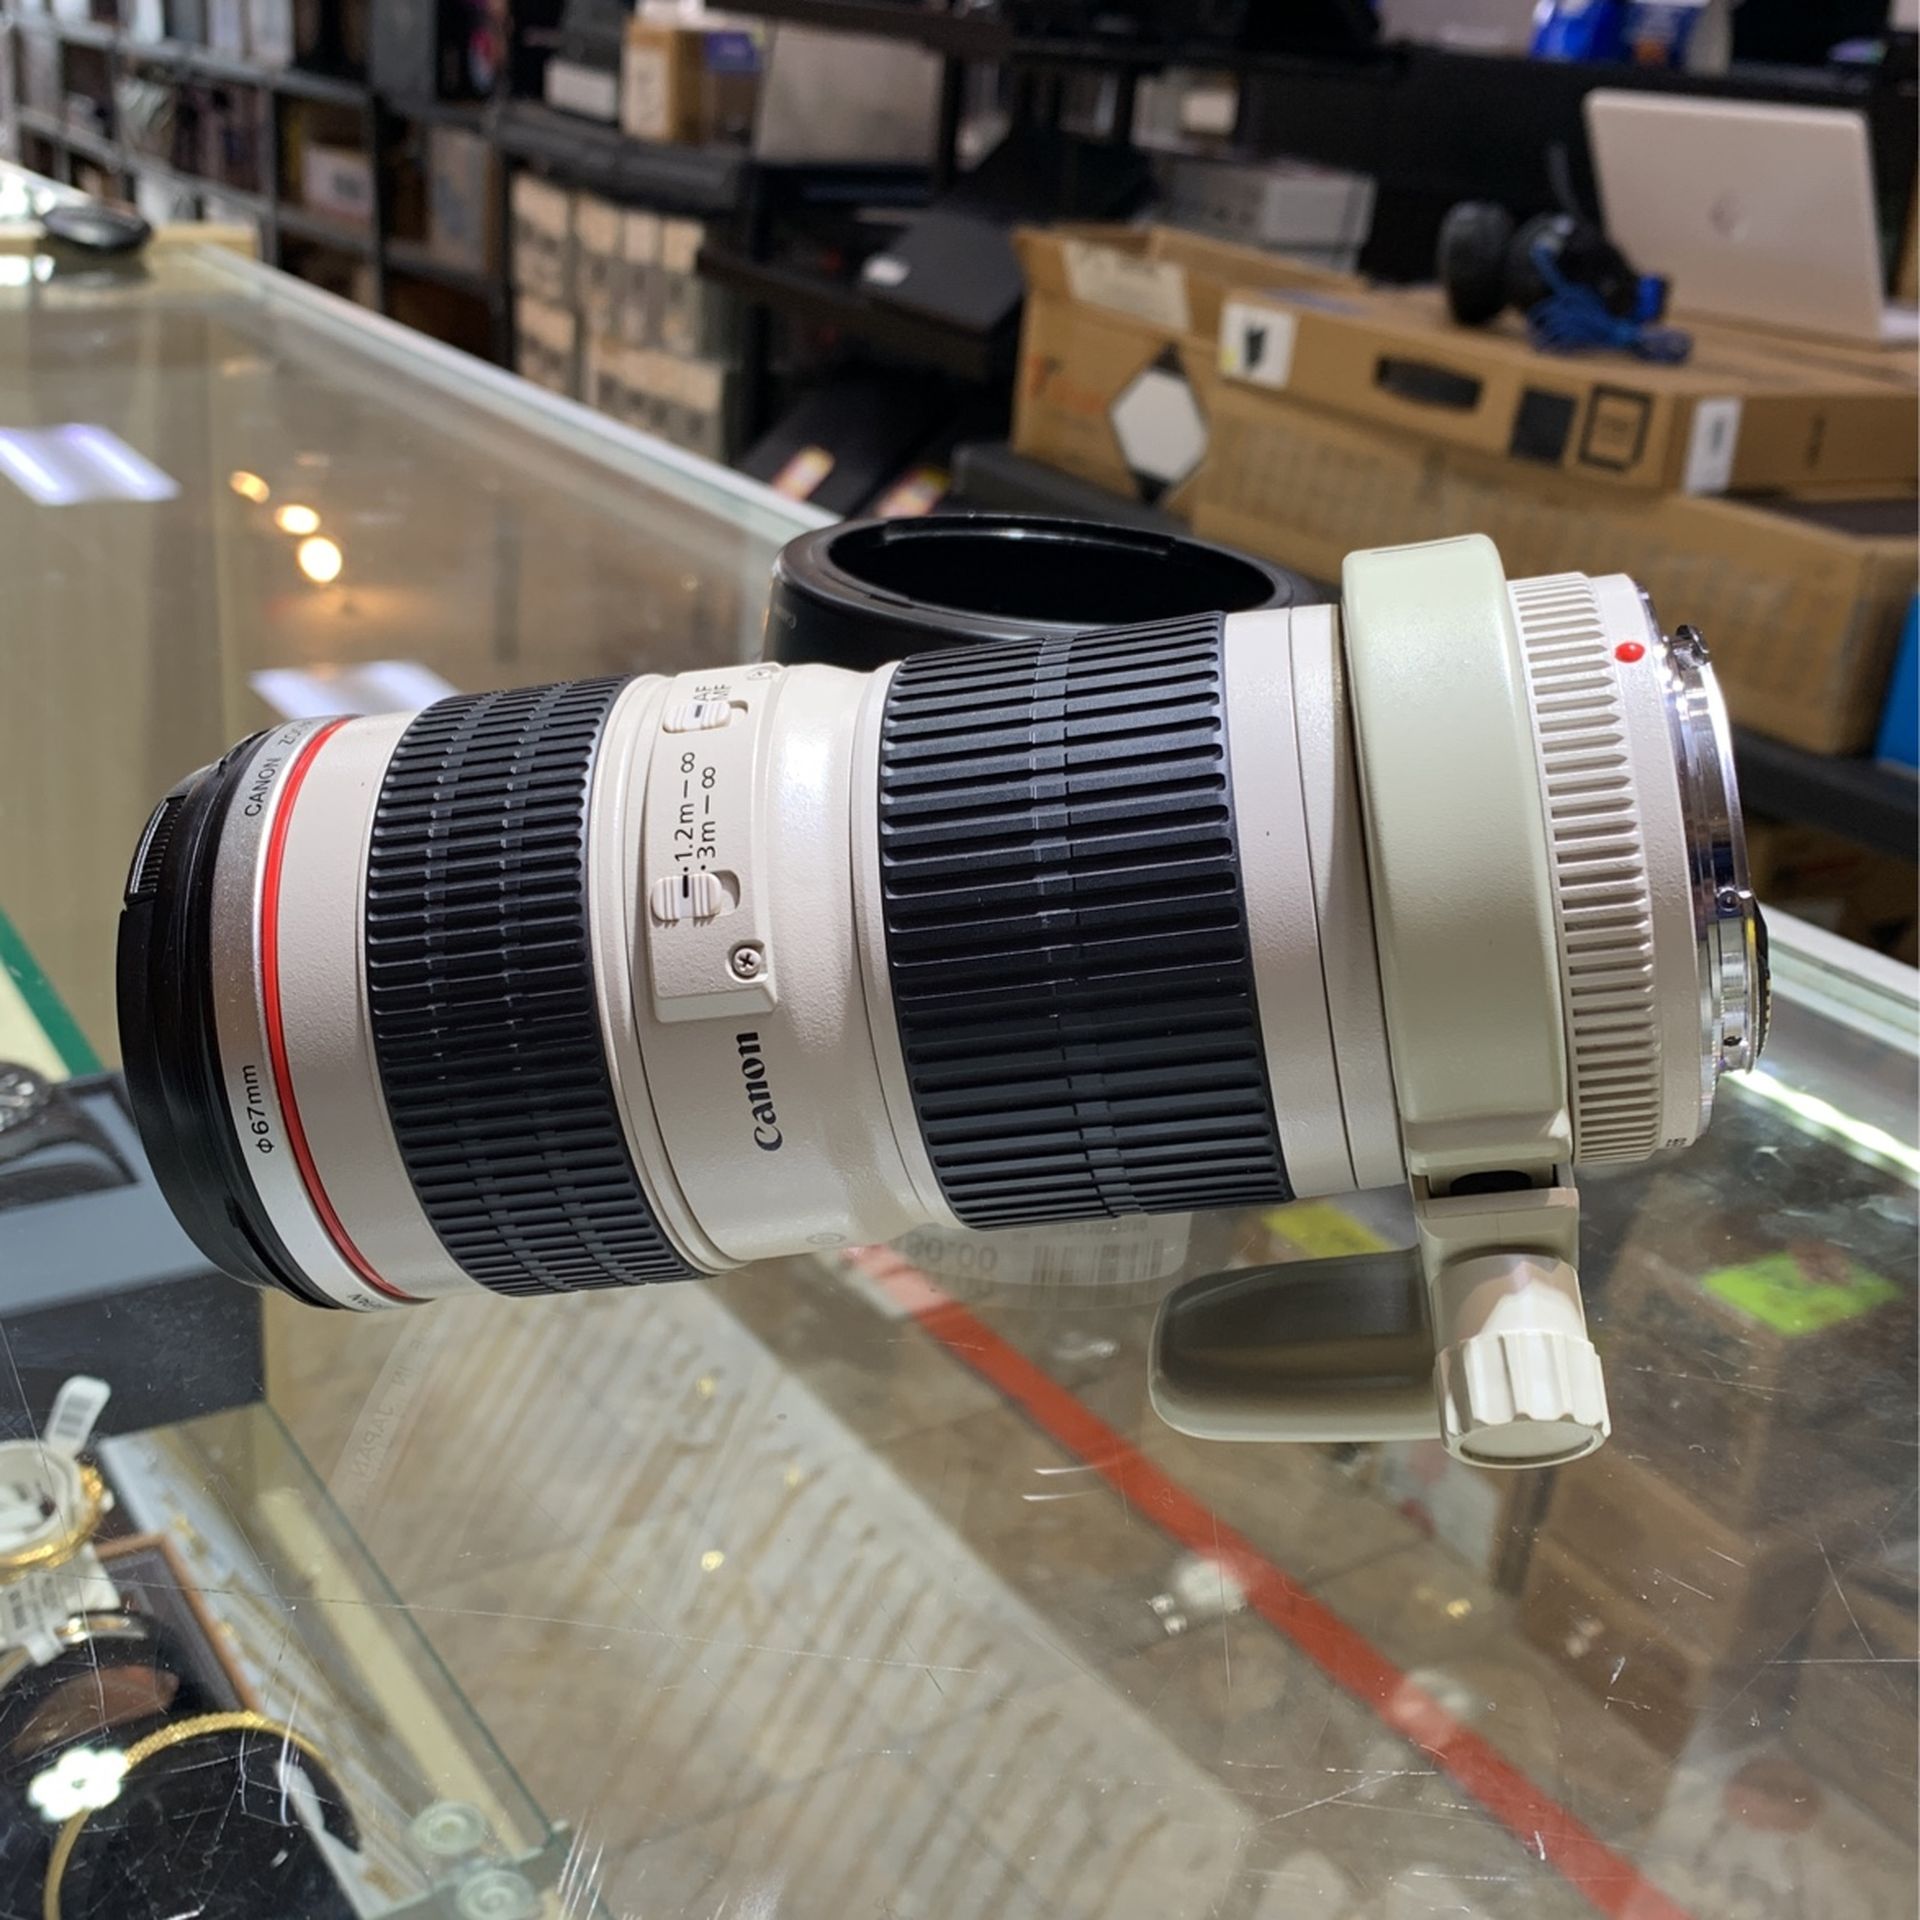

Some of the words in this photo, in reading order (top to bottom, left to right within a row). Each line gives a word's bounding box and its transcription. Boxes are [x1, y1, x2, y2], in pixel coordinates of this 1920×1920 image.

[693, 686, 712, 702] AF
[244, 758, 281, 817] CANON
[736, 1032, 783, 1151] Canon
